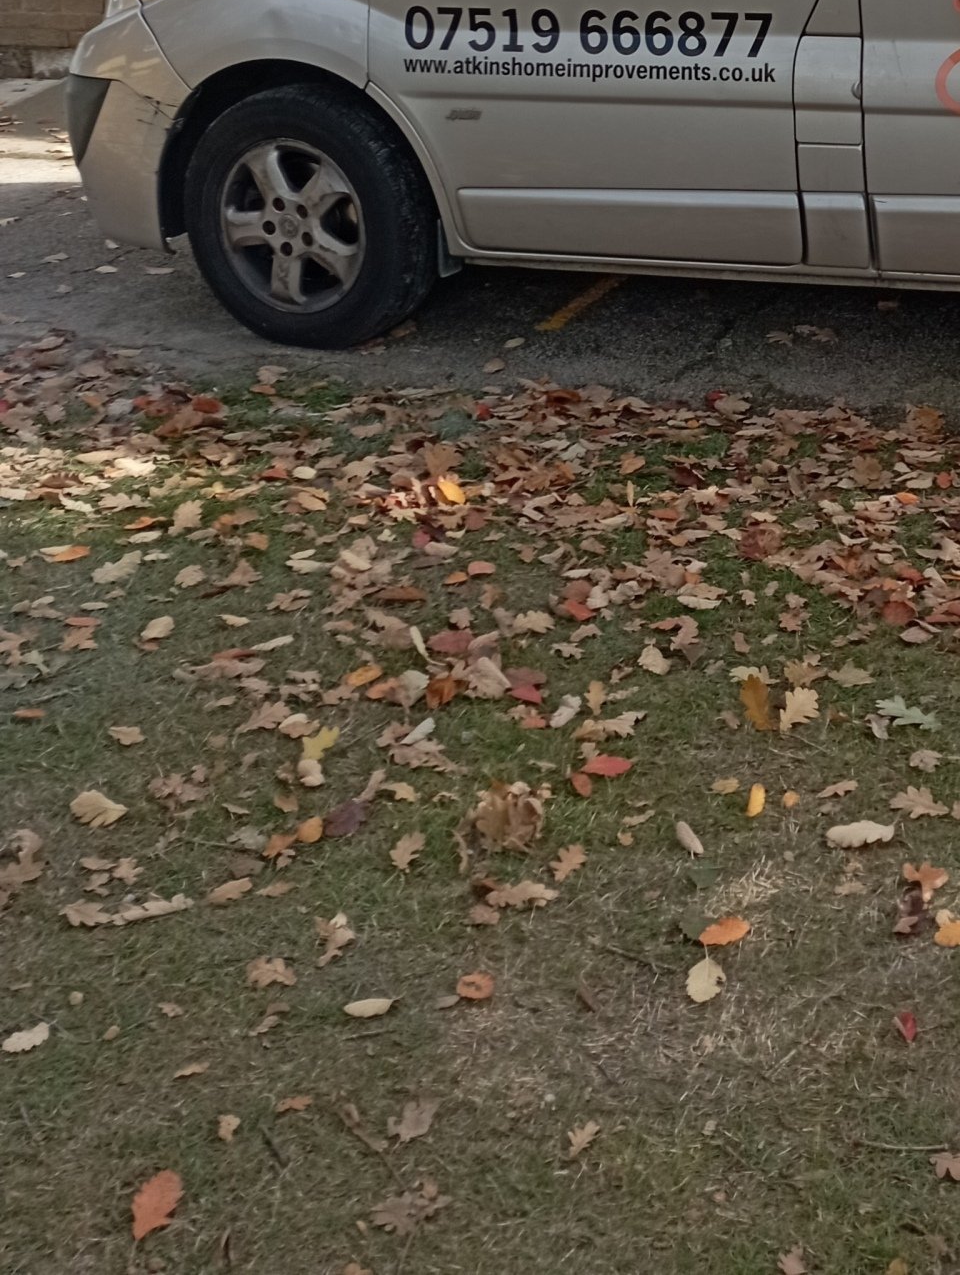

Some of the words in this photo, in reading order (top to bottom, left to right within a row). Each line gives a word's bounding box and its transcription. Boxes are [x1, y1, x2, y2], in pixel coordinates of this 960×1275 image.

[404, 5, 560, 54] 07519
[579, 9, 773, 58] 666877
[403, 55, 776, 83] www.atkinshomeimprovements.co.uk
